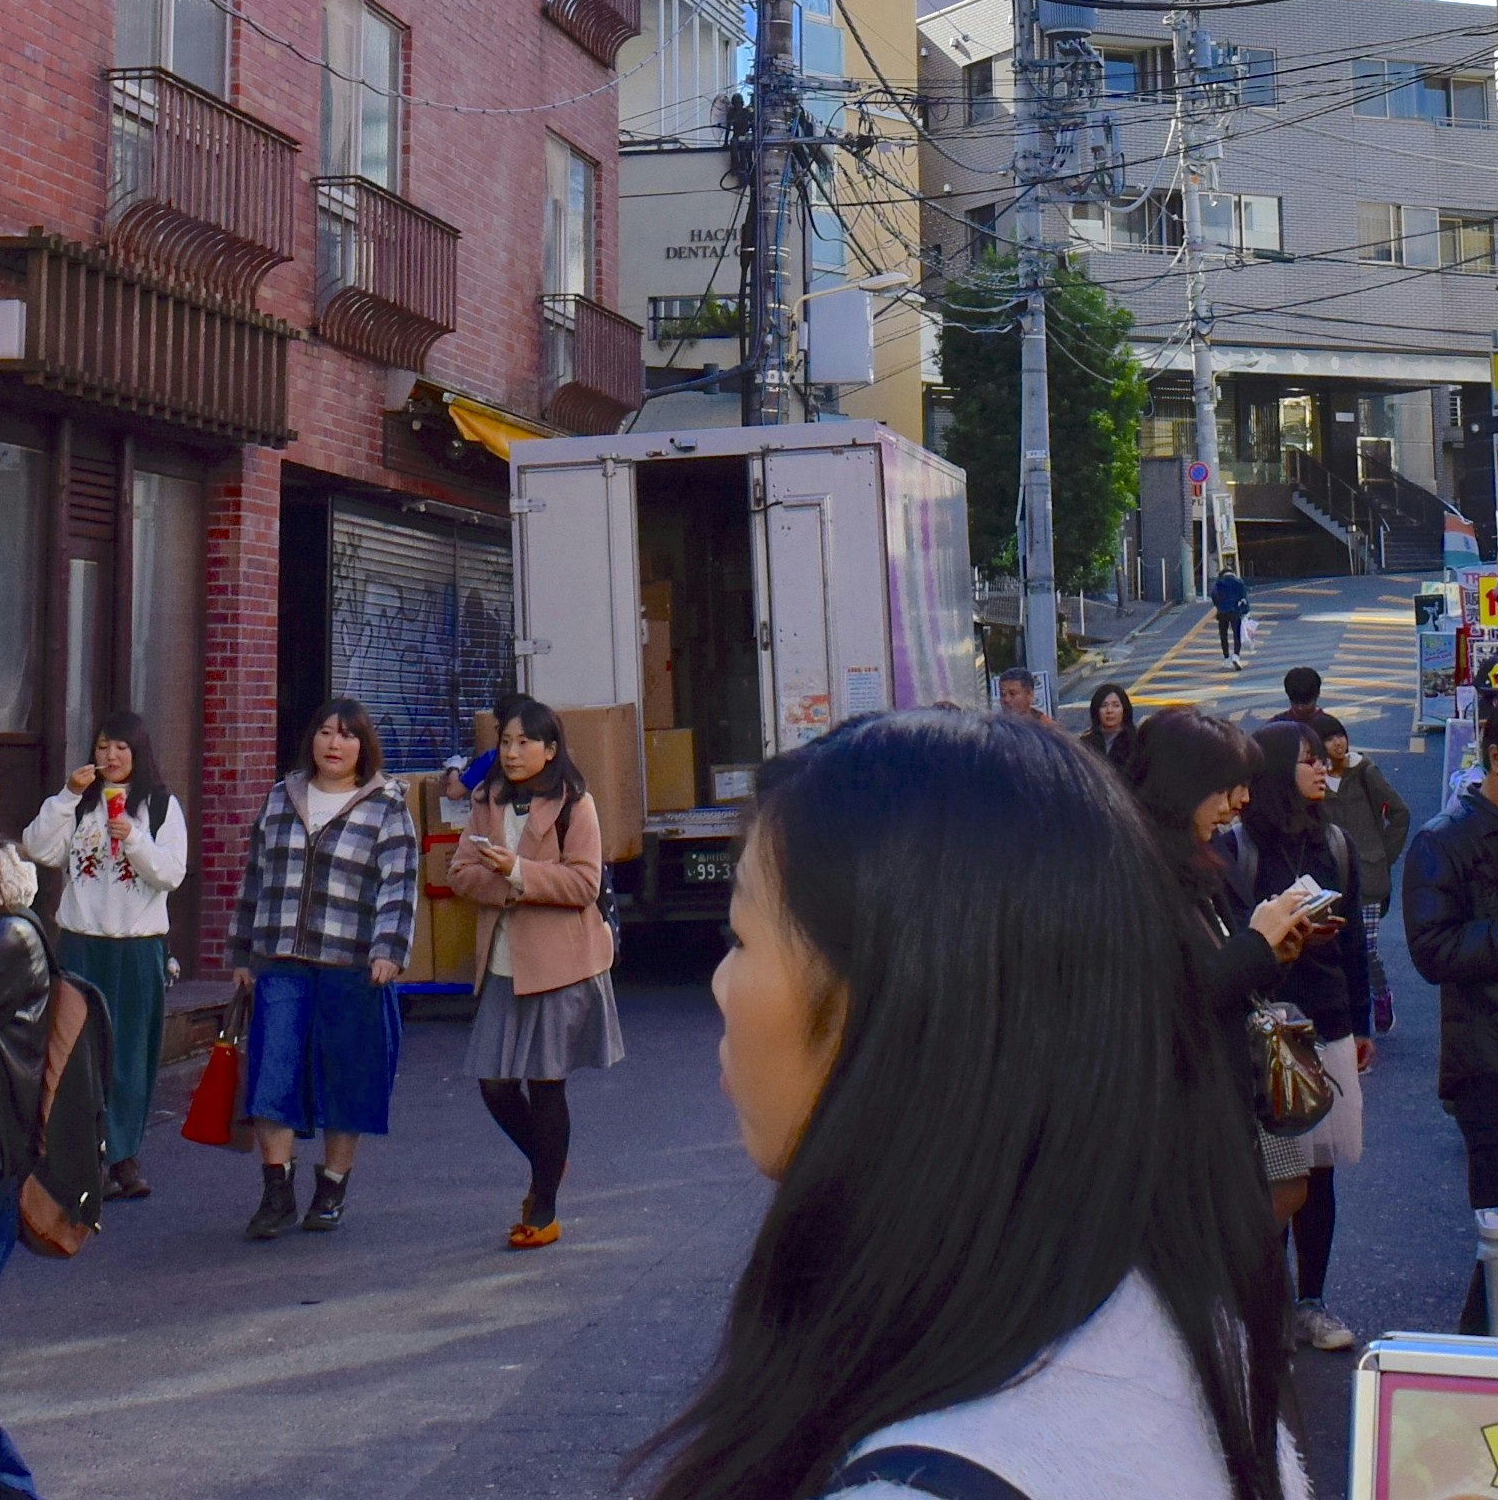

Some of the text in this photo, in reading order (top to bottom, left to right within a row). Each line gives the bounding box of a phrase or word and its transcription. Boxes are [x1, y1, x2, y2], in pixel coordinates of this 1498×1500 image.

[690, 229, 742, 242] HACH
[665, 246, 729, 259] DENTAL
[697, 863, 732, 880] 99-3
